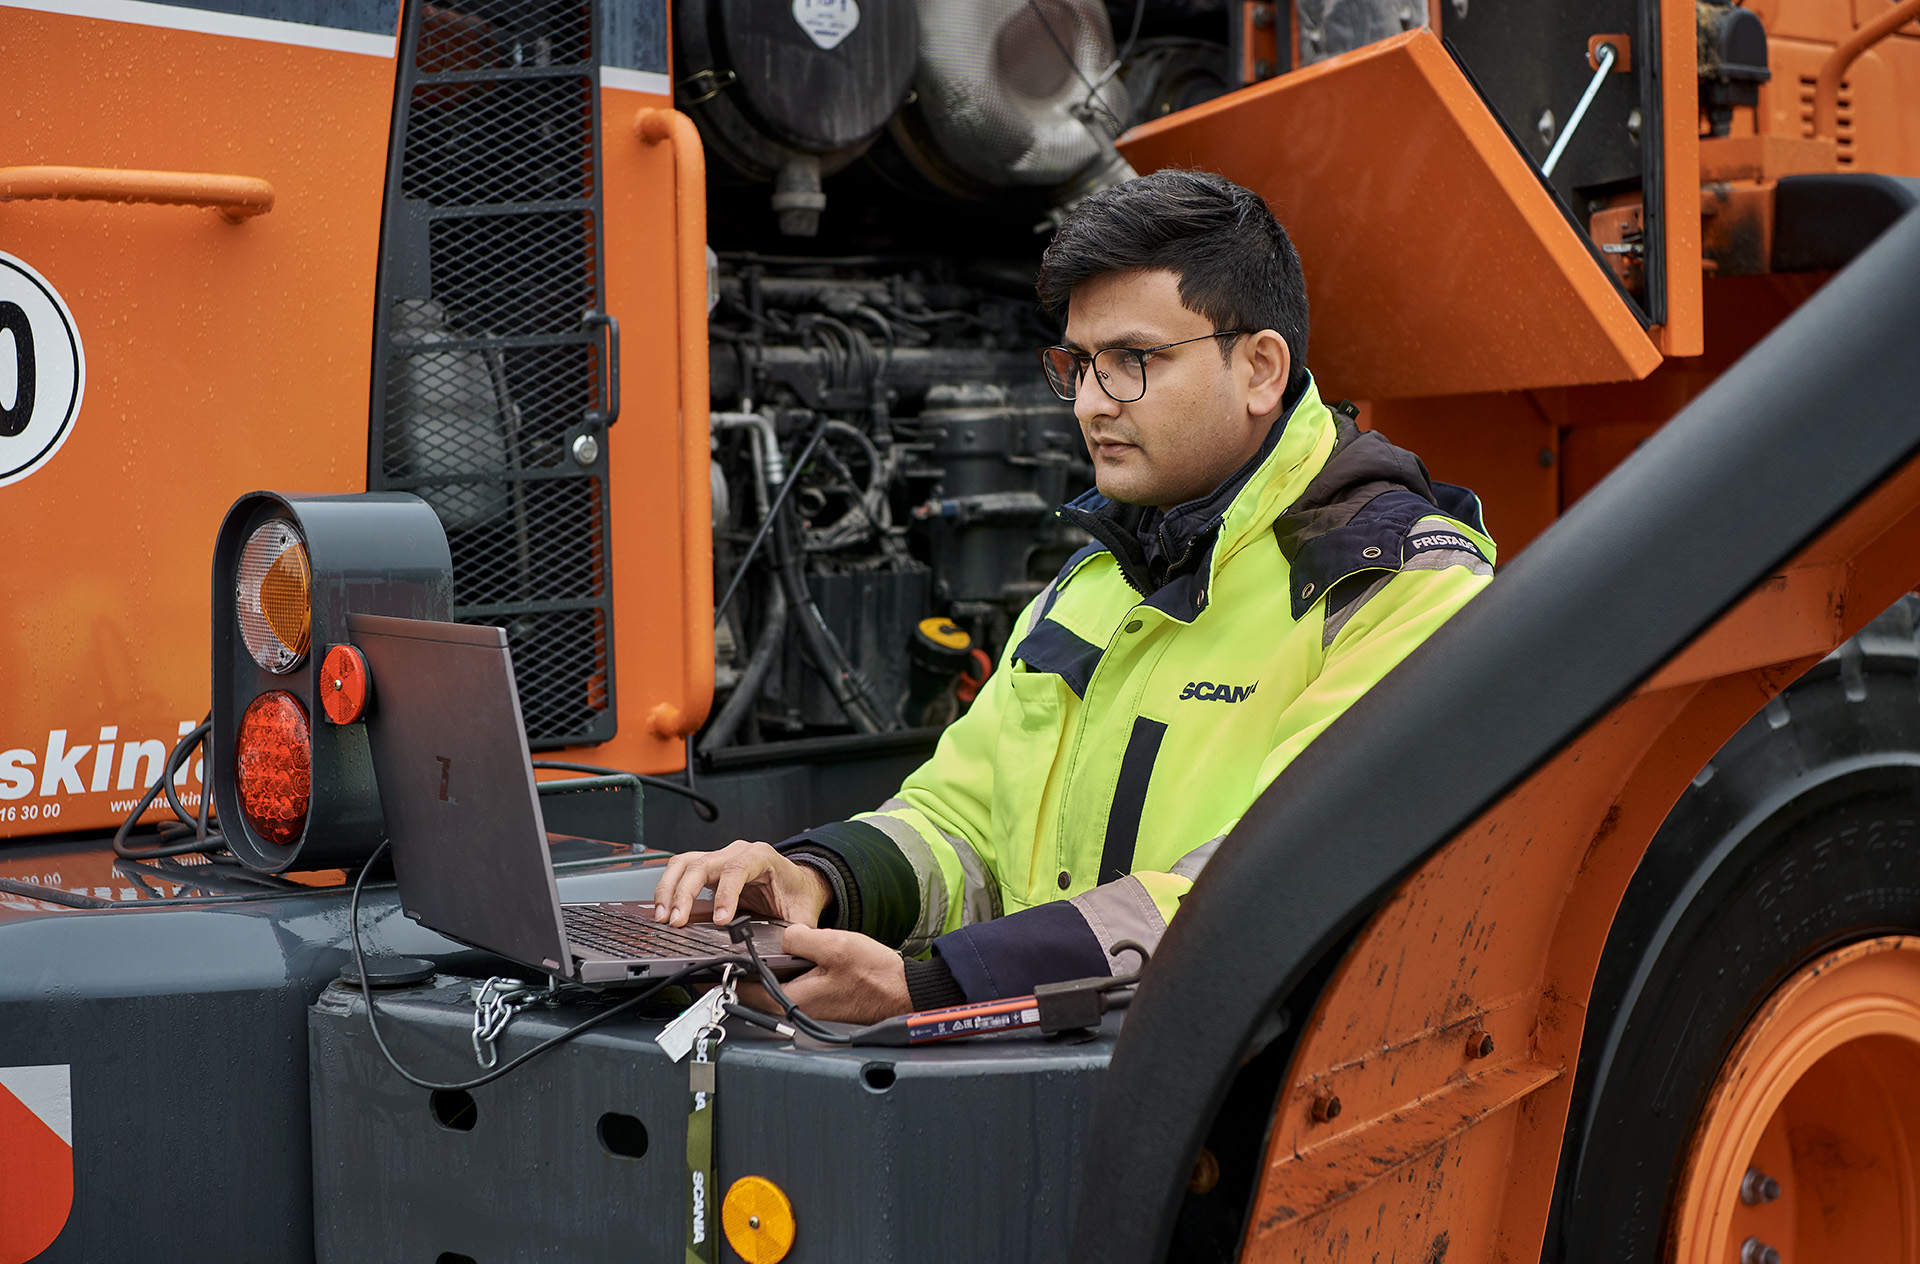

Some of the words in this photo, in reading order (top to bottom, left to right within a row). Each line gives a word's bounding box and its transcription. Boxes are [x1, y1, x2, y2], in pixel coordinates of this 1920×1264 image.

[0, 721, 205, 800] skini
[20, 804, 39, 820] 30
[42, 802, 61, 818] 00
[692, 1170, 705, 1245] SCANIA
